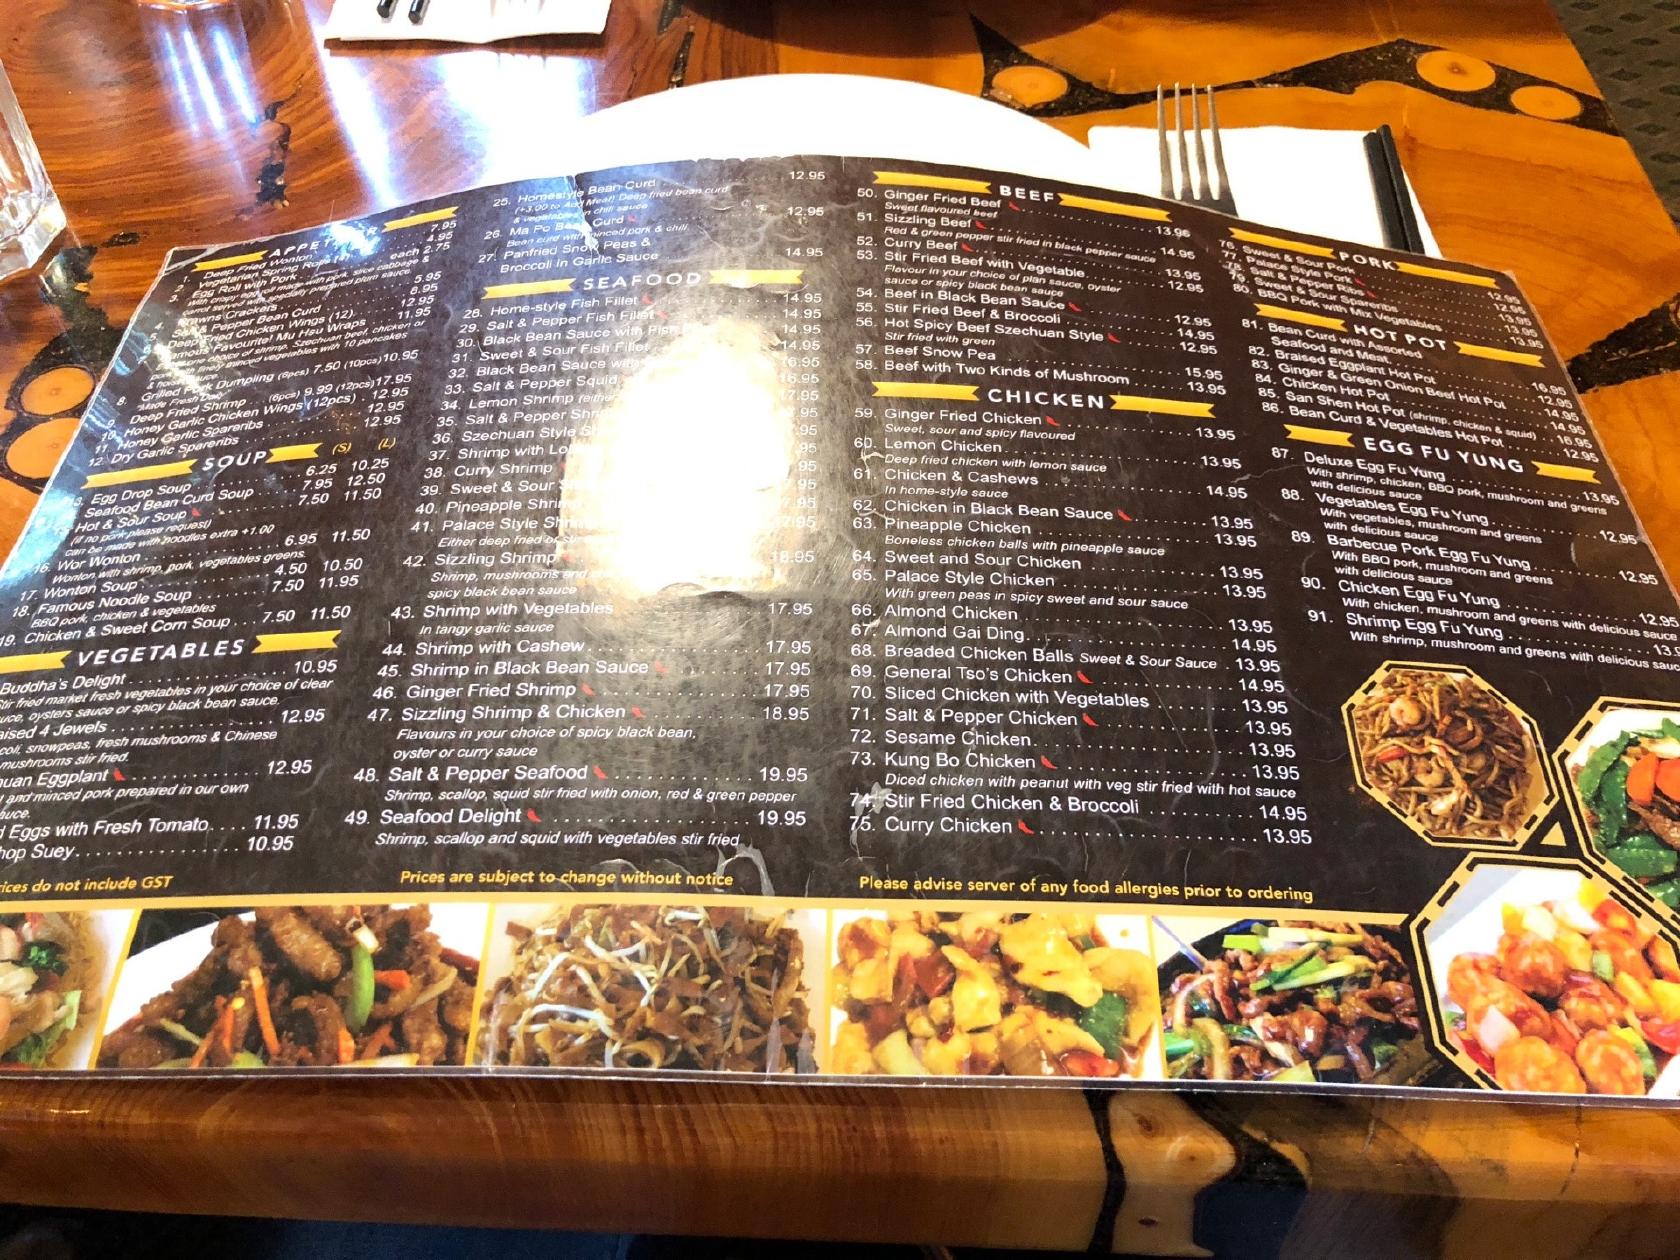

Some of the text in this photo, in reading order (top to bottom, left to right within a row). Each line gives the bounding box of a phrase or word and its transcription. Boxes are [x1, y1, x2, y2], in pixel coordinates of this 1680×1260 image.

[790, 171, 825, 180] 12.95
[884, 190, 928, 202] Ginger
[934, 193, 966, 204] Fried
[971, 197, 1000, 208] Beef
[1000, 186, 1053, 202] BEEF
[1340, 252, 1398, 270] PORK
[584, 273, 702, 290] SEAFOOD
[571, 298, 599, 308] Fish
[783, 292, 822, 303] 14.95
[885, 289, 917, 298] Beef
[921, 290, 933, 299] in
[938, 290, 976, 302] Black
[981, 294, 1016, 305] Bean
[1022, 297, 1064, 309] Sauce
[1175, 315, 1212, 326] 12.95
[885, 332, 905, 340] Stir
[908, 333, 933, 341] fried
[962, 338, 995, 346] green
[1354, 325, 1445, 350] HOT POT
[885, 360, 919, 371] Beef
[922, 362, 951, 372] with
[956, 363, 985, 374] Two
[990, 366, 1030, 377] Kinds
[1035, 369, 1048, 378] of
[1054, 370, 1129, 384] Mushroom
[1188, 382, 1226, 395] 13.95
[1282, 377, 1336, 392] Chicken
[1340, 385, 1363, 396] Hot
[1367, 389, 1390, 401] Pot
[988, 389, 1103, 408] CHICKEN
[365, 414, 401, 427] 12.95
[885, 408, 934, 422] Ginger
[940, 410, 976, 422] Fried
[983, 412, 1041, 424] Chicken
[1196, 428, 1235, 440] 13.95
[333, 438, 396, 454] (S) (L)
[1364, 438, 1523, 472] EGG FU YUNG
[205, 451, 268, 473] SOUP
[91, 458, 389, 505] Egg Drop Soup 6.25 10.25
[1304, 452, 1353, 467] Deluxe
[1356, 459, 1384, 474] Egg
[1388, 464, 1406, 474] Fu
[1409, 466, 1445, 482] Yung
[1583, 492, 1619, 505] 13.95
[1310, 480, 1422, 500] with delicious sauce
[44, 585, 96, 598] Wonton
[101, 582, 137, 592] Soup
[275, 563, 307, 575] 4.50
[324, 558, 362, 571] 10.50
[1346, 613, 1400, 631] Shrimp
[1405, 618, 1436, 634] Egg
[1440, 621, 1460, 633] Fu
[1463, 623, 1503, 640] Yung
[79, 640, 244, 666] VEGETABLES
[416, 642, 473, 656] Shrimp
[479, 640, 511, 653] with
[517, 639, 586, 655] Cashew
[767, 640, 811, 654] 17.95
[885, 644, 954, 658] Breaded
[961, 646, 1026, 660] Chicken
[1033, 648, 1073, 662] Balls
[1080, 653, 1121, 664] Sweet
[1126, 655, 1134, 665] &
[1140, 655, 1172, 666] Sour
[1176, 657, 1216, 668] Sauce
[1236, 658, 1280, 672] 13.95
[0, 660, 337, 695] Buddha's Delight 10.95
[885, 686, 935, 700] Sliced
[942, 688, 1009, 702] Chicken
[1016, 690, 1048, 703] with
[1054, 691, 1149, 708] Vegetables
[1242, 699, 1288, 714] 13.95
[885, 774, 1296, 798] Diced chicken with peanut with veg stir fried with hot sauce
[9, 814, 299, 842] Eggs with Fresh Tomato 11.95
[380, 809, 453, 824] Seafood
[459, 808, 522, 826] Delight
[758, 810, 806, 826] 19.95
[376, 832, 740, 847] Shrimp, scallop and squid with vegetables stir fried
[886, 817, 934, 836] Curry
[940, 818, 1012, 833] Chicken
[1264, 829, 1312, 844] 13.95
[32, 879, 51, 892] do
[55, 880, 80, 891] not
[84, 877, 136, 890] include
[142, 876, 173, 888] GST
[401, 870, 734, 886] Prices are subject to change without notice
[860, 876, 1312, 903] Please advise server of any food allergies prior to ordering
